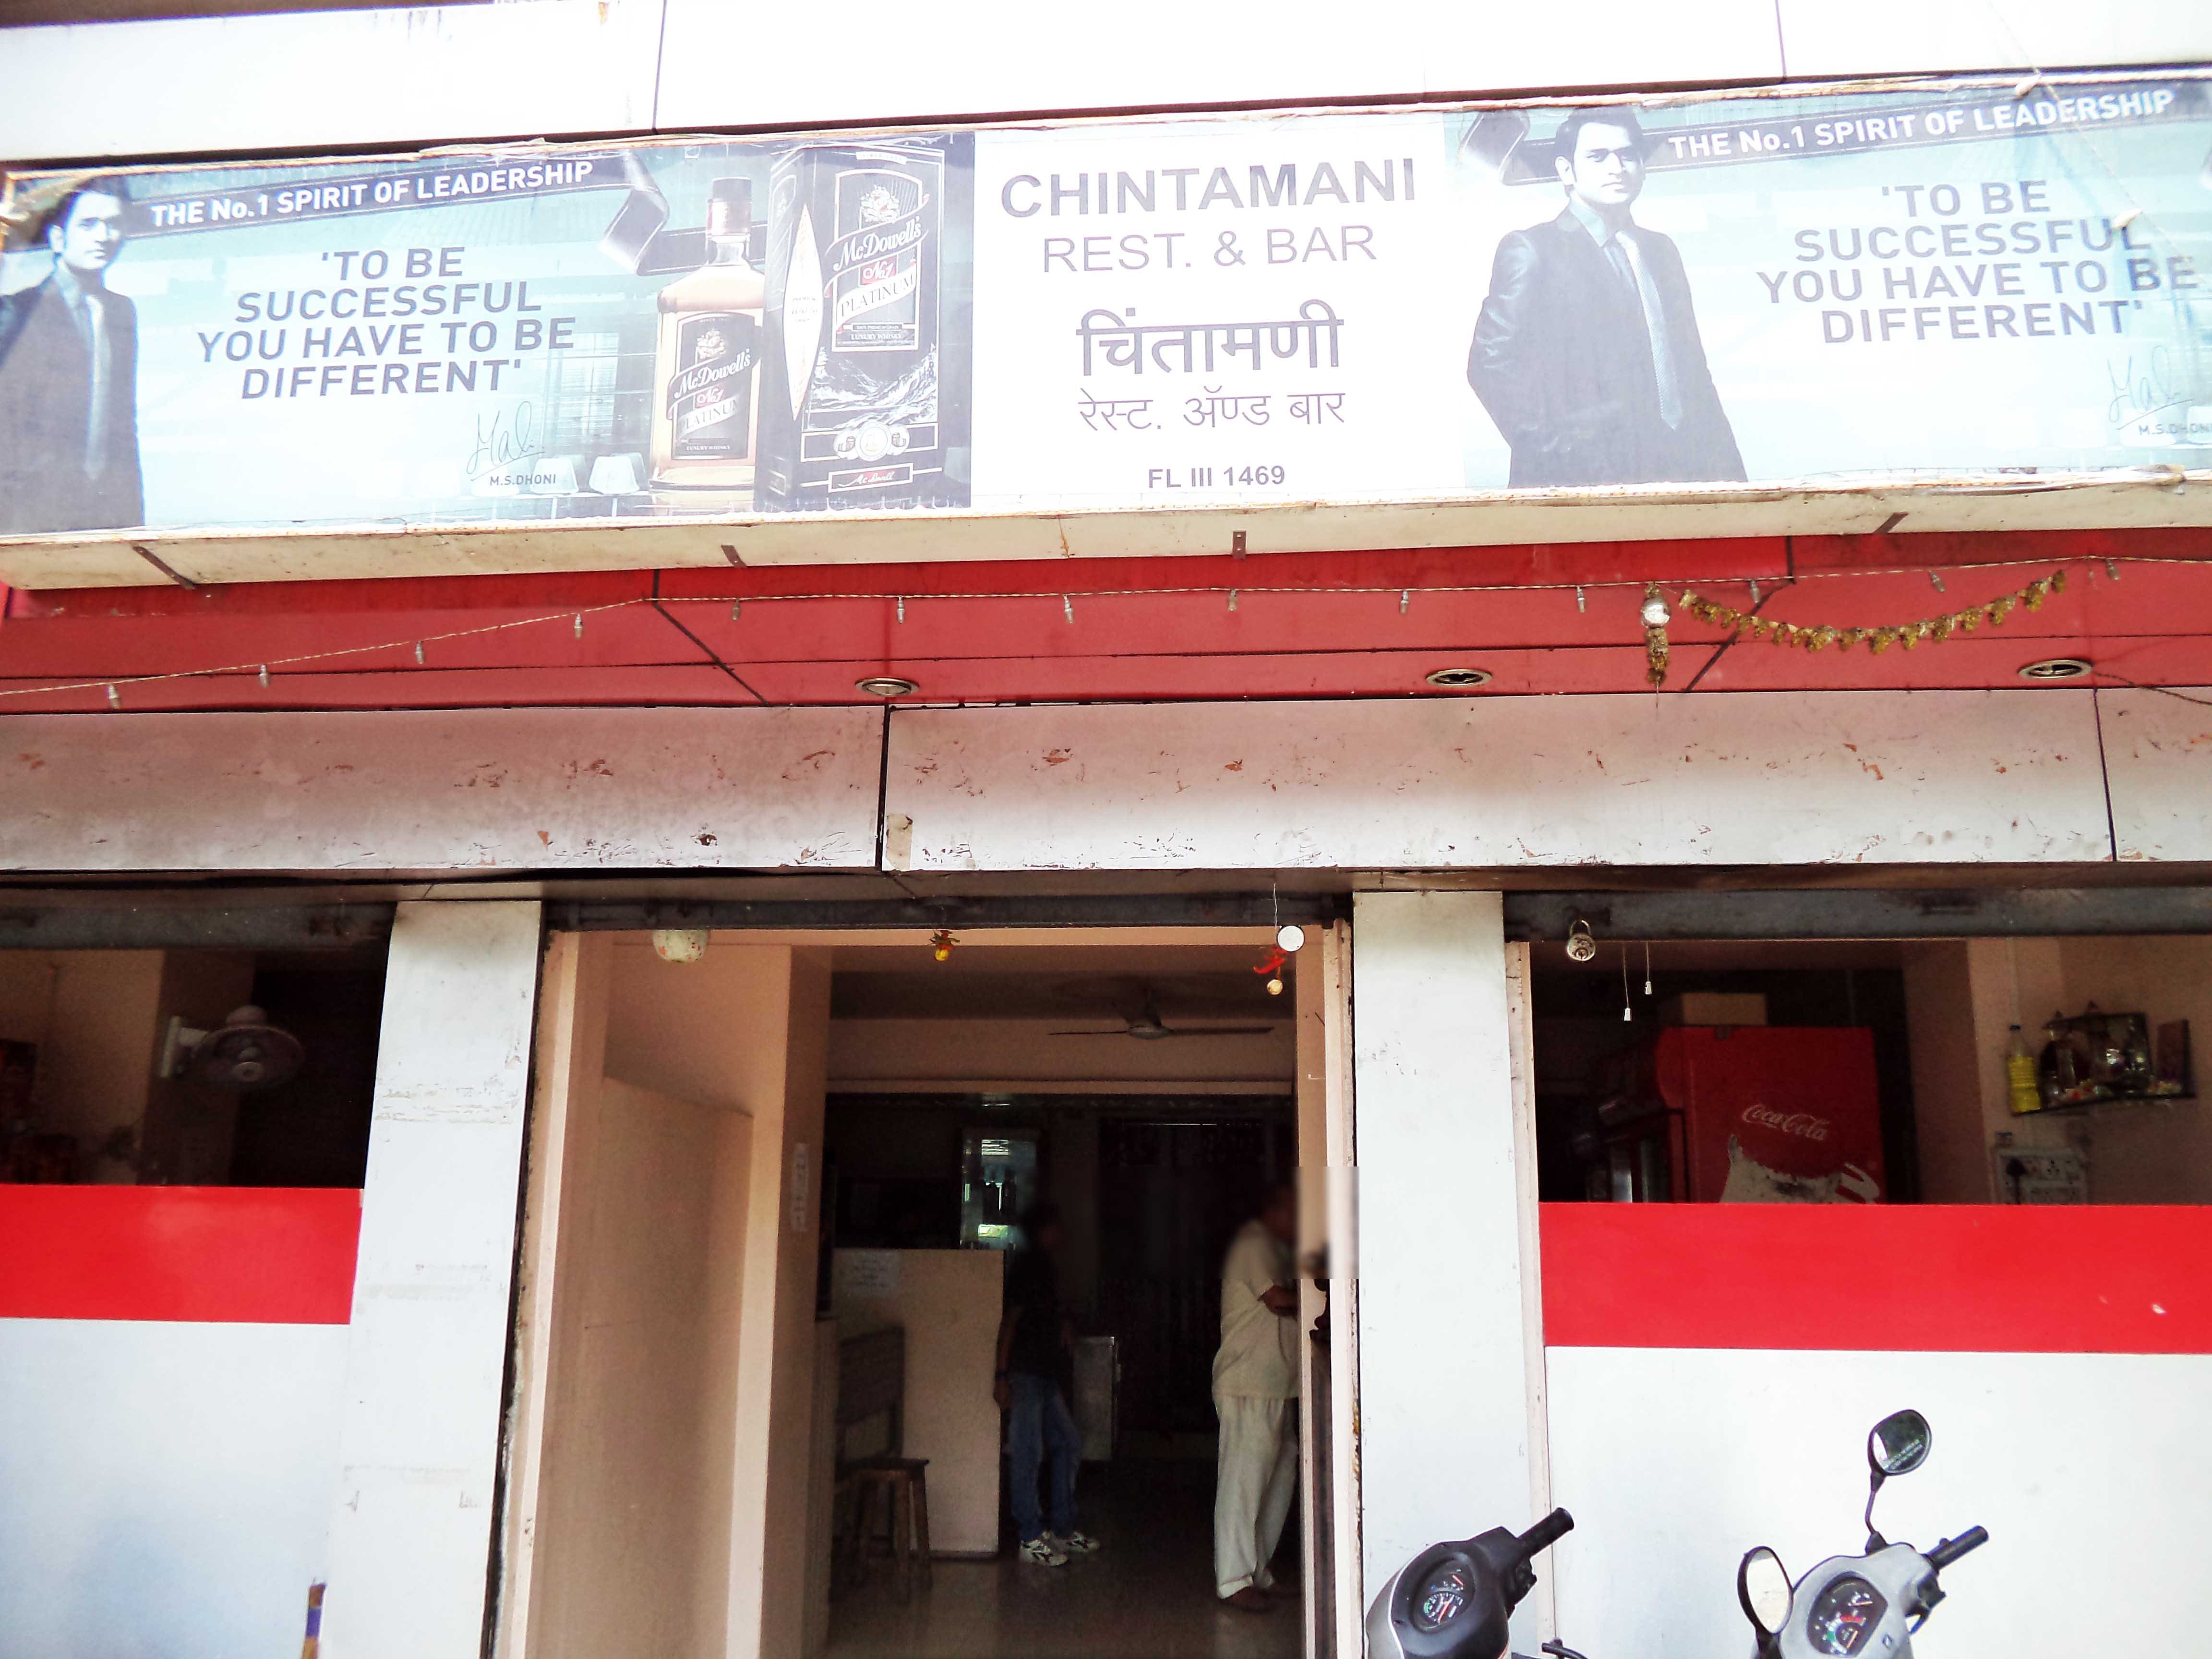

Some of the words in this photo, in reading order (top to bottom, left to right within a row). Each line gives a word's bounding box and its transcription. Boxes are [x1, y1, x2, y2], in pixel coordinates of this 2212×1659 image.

[1668, 132, 1732, 159] THE
[1740, 126, 1805, 152] No.1
[1815, 114, 1916, 147] SPIRIT
[1924, 108, 1964, 135] OF
[1974, 89, 2175, 132] LEADERSHIP
[152, 202, 203, 227] THE
[212, 197, 268, 221] No.1
[277, 185, 367, 215] SPIRIT
[378, 180, 409, 204] OF
[417, 160, 593, 200] LEADERSHIP
[1000, 158, 1415, 218] CHINTAMANI
[1980, 180, 2051, 214] BE
[833, 216, 922, 271] McDowell's
[1044, 232, 1191, 273] REST.
[1213, 229, 1246, 266] &
[1267, 224, 1377, 264] BAR
[1794, 218, 2151, 262] SUCCESSFUL
[405, 246, 466, 279] BE
[1756, 269, 1863, 303] YOU
[1884, 264, 2024, 300] HAVE
[2040, 260, 2107, 292] TO
[2126, 256, 2198, 290] BE
[235, 281, 542, 322] SUCCESSFUL
[841, 274, 914, 317] PLATINUM
[196, 330, 286, 363] YOU
[302, 324, 424, 359] HAVE
[440, 320, 498, 354] TO
[515, 316, 577, 350] BE
[1076, 299, 1344, 377] चिंतामणी
[1821, 300, 2143, 343] DIFFERENT'
[240, 359, 522, 400] DIFFERENT'
[674, 348, 751, 398] McDowell's
[1287, 392, 1346, 426] बार
[490, 474, 556, 486] M.S.DHONI
[1148, 468, 1181, 488] FL
[1191, 467, 1213, 487] III
[1223, 465, 1286, 486] 1469
